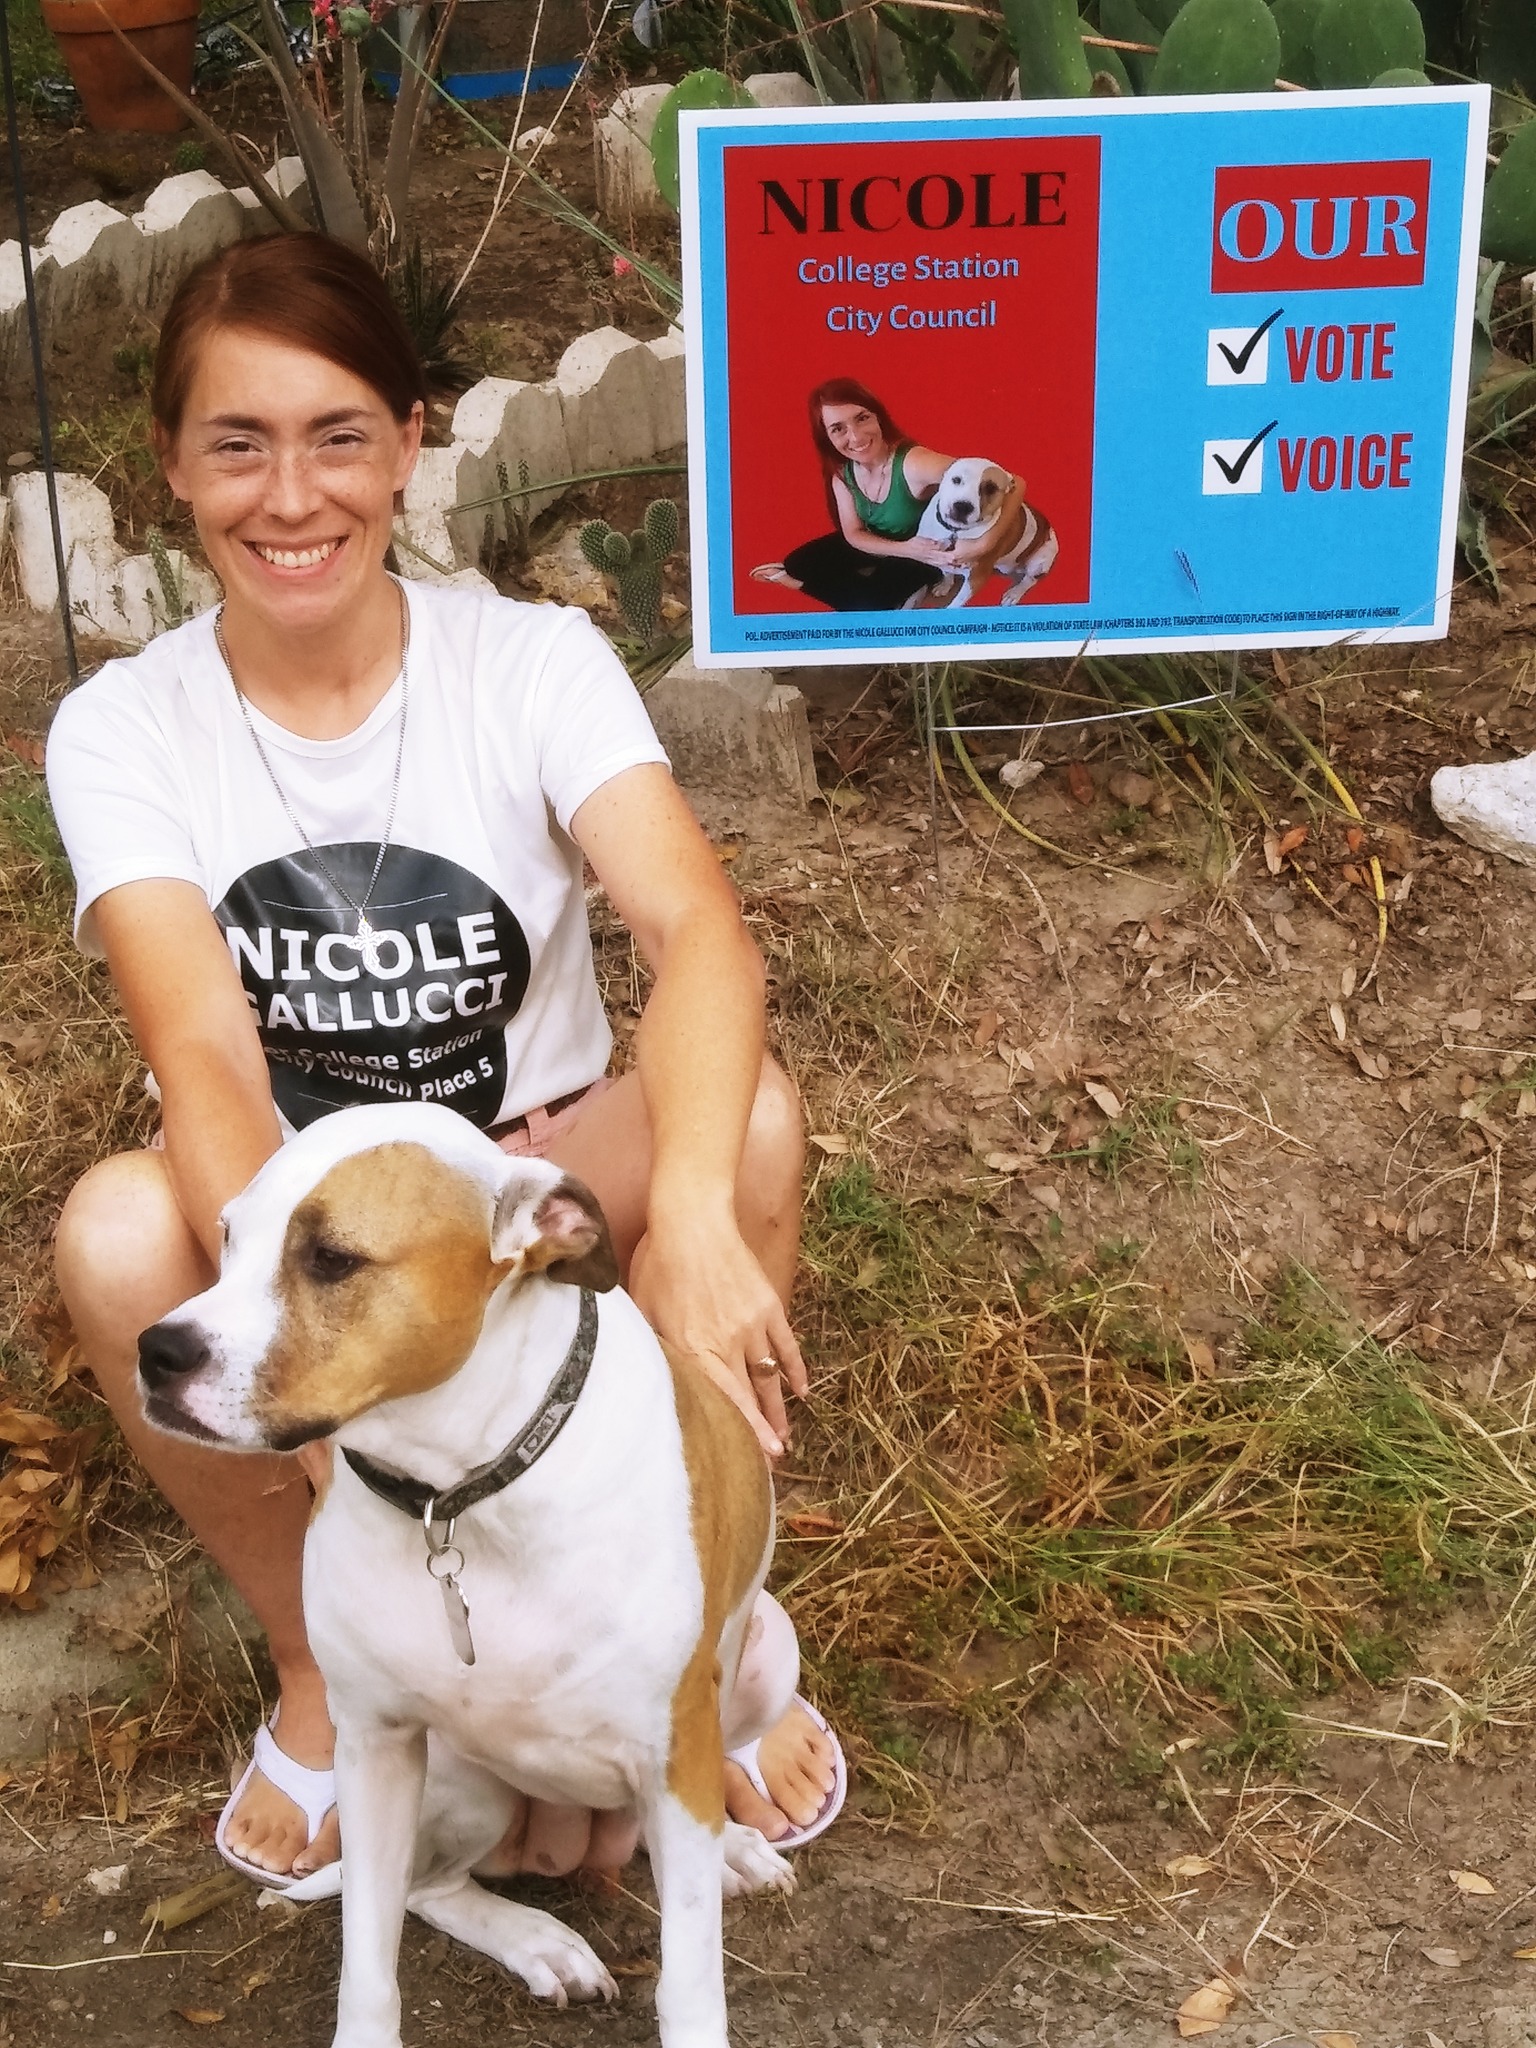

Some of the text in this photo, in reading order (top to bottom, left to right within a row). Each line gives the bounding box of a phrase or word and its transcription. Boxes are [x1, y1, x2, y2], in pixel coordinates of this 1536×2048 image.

[757, 171, 1067, 235] NICOLE
[1218, 195, 1420, 263] OUR
[798, 252, 1019, 288] College Station
[826, 300, 996, 337] City Council
[1284, 322, 1396, 384] VOTE
[1277, 432, 1414, 493] VOICE
[225, 911, 501, 982] NICOLE
[408, 1028, 483, 1069] Station
[420, 1069, 477, 1102] Place
[478, 1056, 494, 1078] 5
